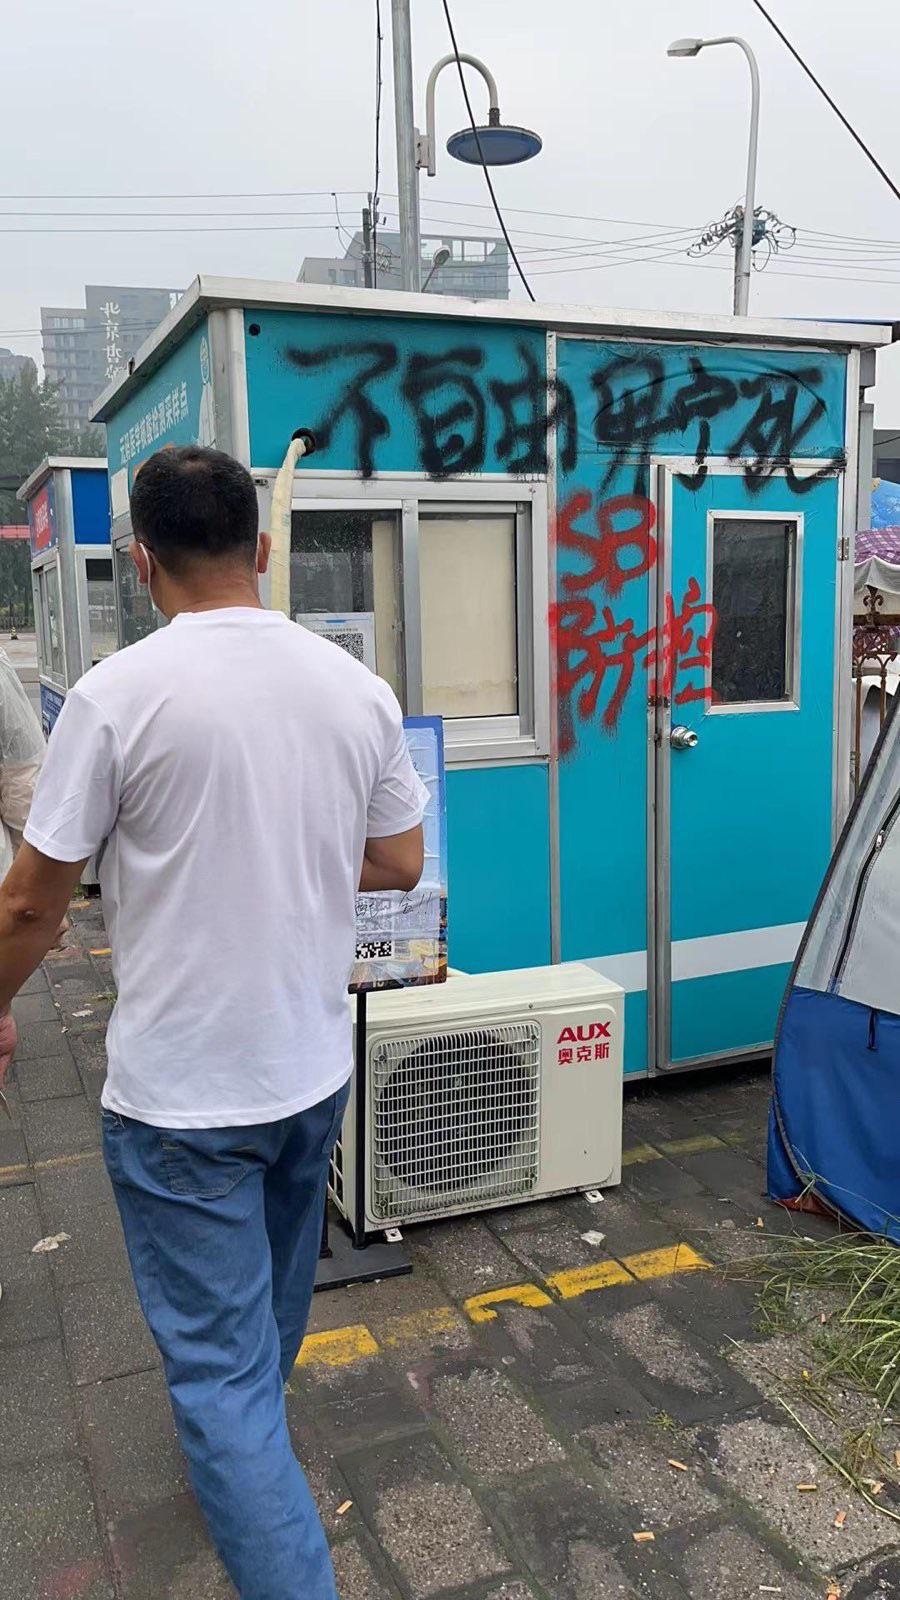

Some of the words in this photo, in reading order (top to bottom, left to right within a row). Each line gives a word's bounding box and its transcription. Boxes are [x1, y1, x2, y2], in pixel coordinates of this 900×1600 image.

[555, 492, 658, 596] SB
[547, 577, 719, 755] 防控
[557, 1021, 611, 1044] AUX
[558, 1042, 609, 1066] 奥克斯
